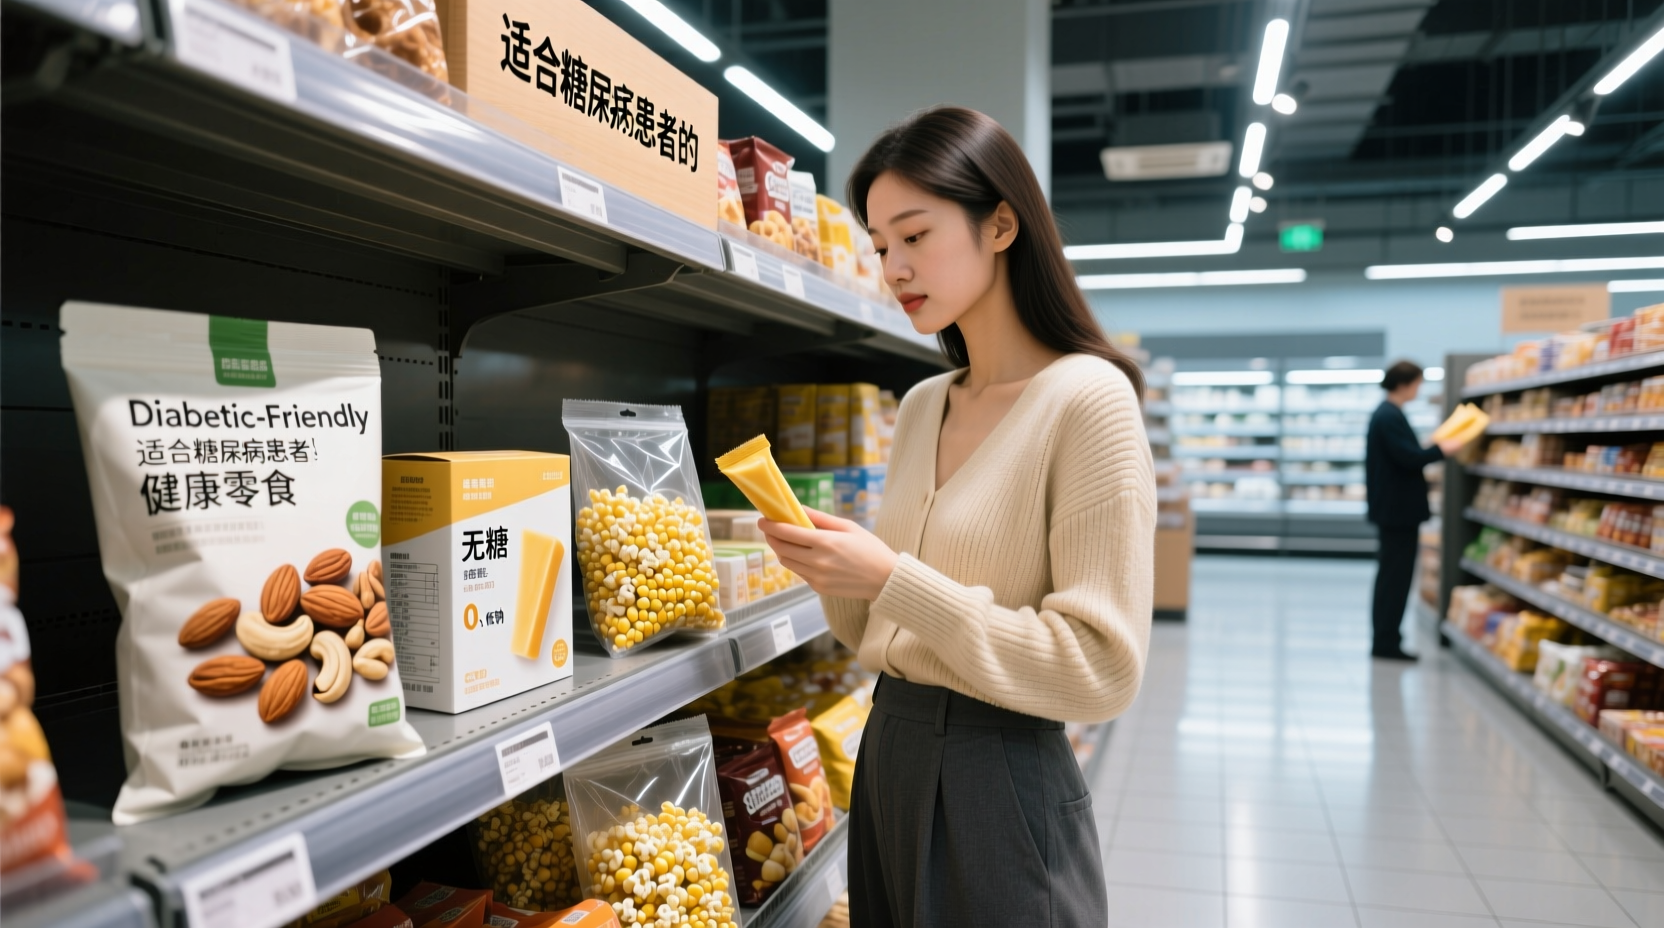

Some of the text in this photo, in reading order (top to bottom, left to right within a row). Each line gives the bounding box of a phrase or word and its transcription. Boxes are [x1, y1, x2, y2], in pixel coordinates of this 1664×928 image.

[500, 13, 699, 172] 适合糖尿病患者的
[128, 399, 369, 435] Diabetic-Friendly
[139, 468, 296, 516] 健康零食
[461, 525, 509, 562] 无糖
